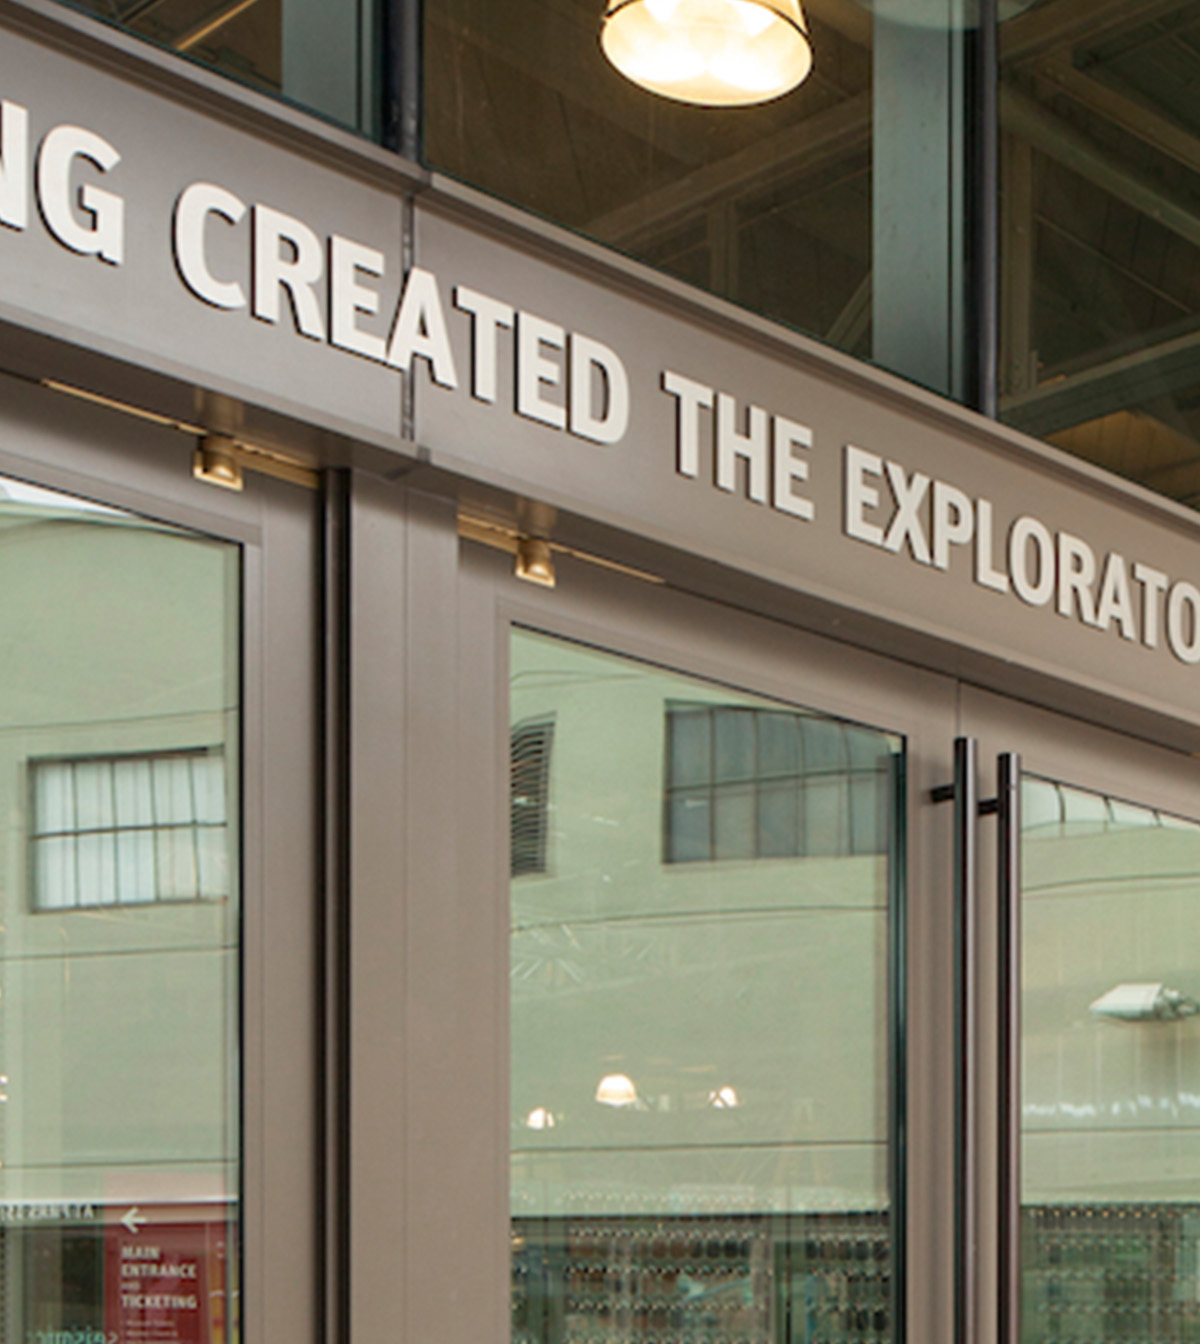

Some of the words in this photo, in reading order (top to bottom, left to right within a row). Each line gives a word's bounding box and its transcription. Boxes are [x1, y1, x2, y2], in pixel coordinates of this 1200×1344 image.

[171, 182, 630, 446] CREATED
[661, 370, 813, 521] THE
[121, 1245, 160, 1260] MAIN
[121, 1263, 197, 1278] ENTRANCE
[121, 1294, 198, 1310] TICKETING
